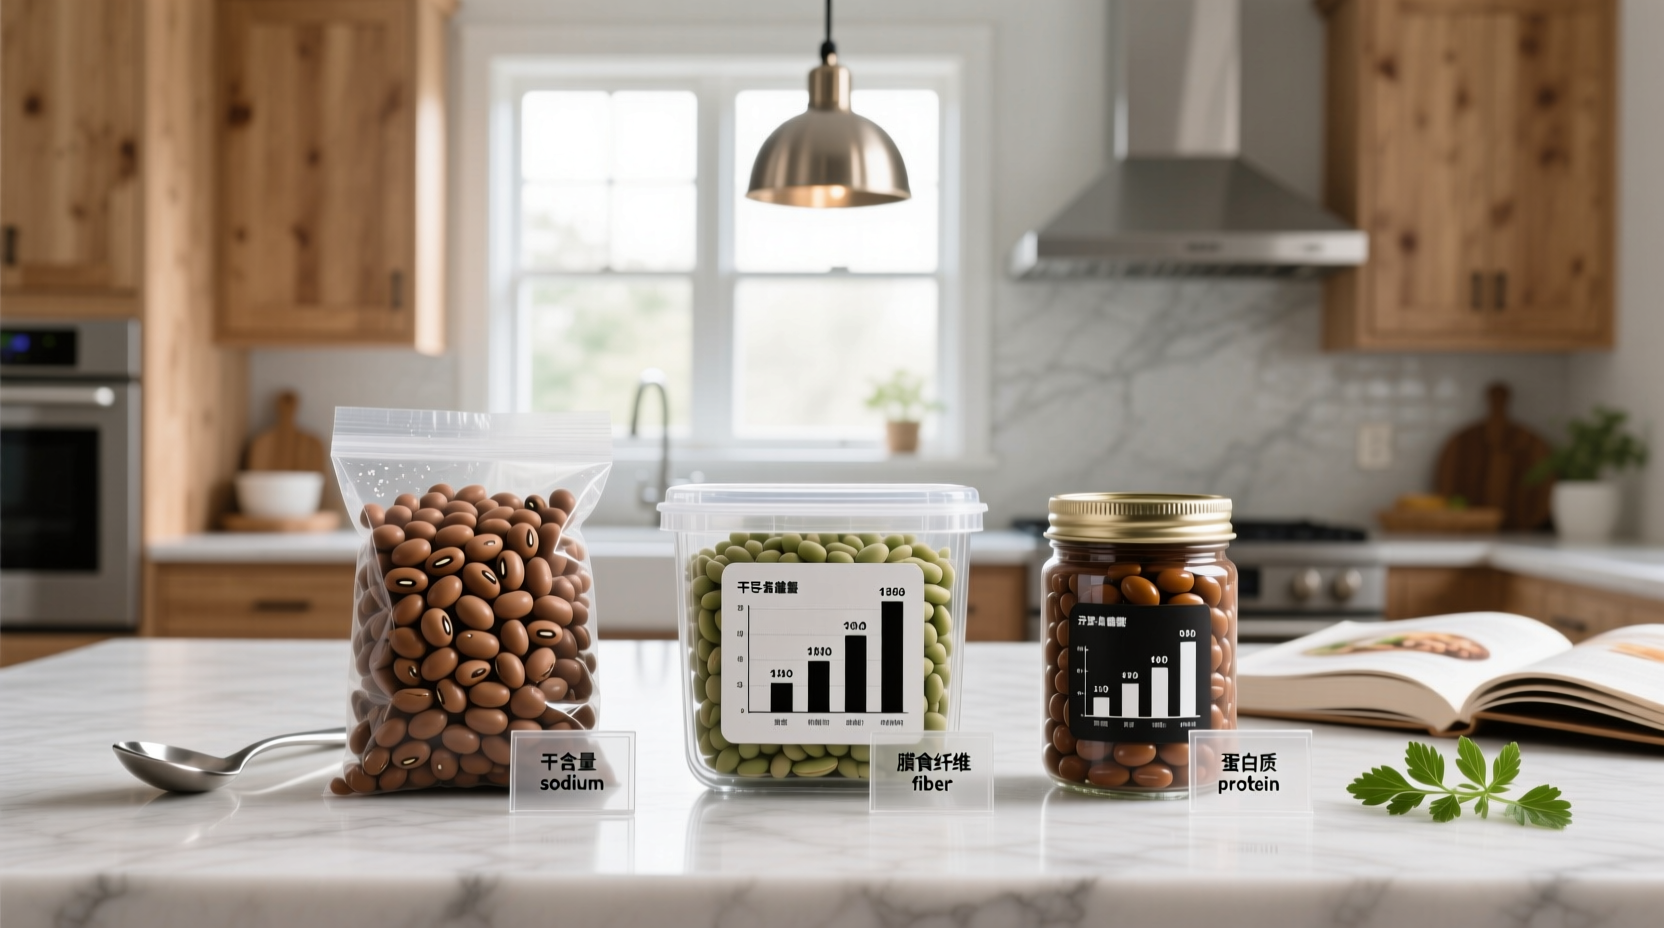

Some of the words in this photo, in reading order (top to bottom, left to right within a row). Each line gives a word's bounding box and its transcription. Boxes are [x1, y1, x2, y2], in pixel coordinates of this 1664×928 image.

[1221, 752, 1277, 773] 蛋白质
[540, 774, 604, 790] sodium
[912, 775, 953, 791] fiber
[1218, 775, 1279, 794] protein
